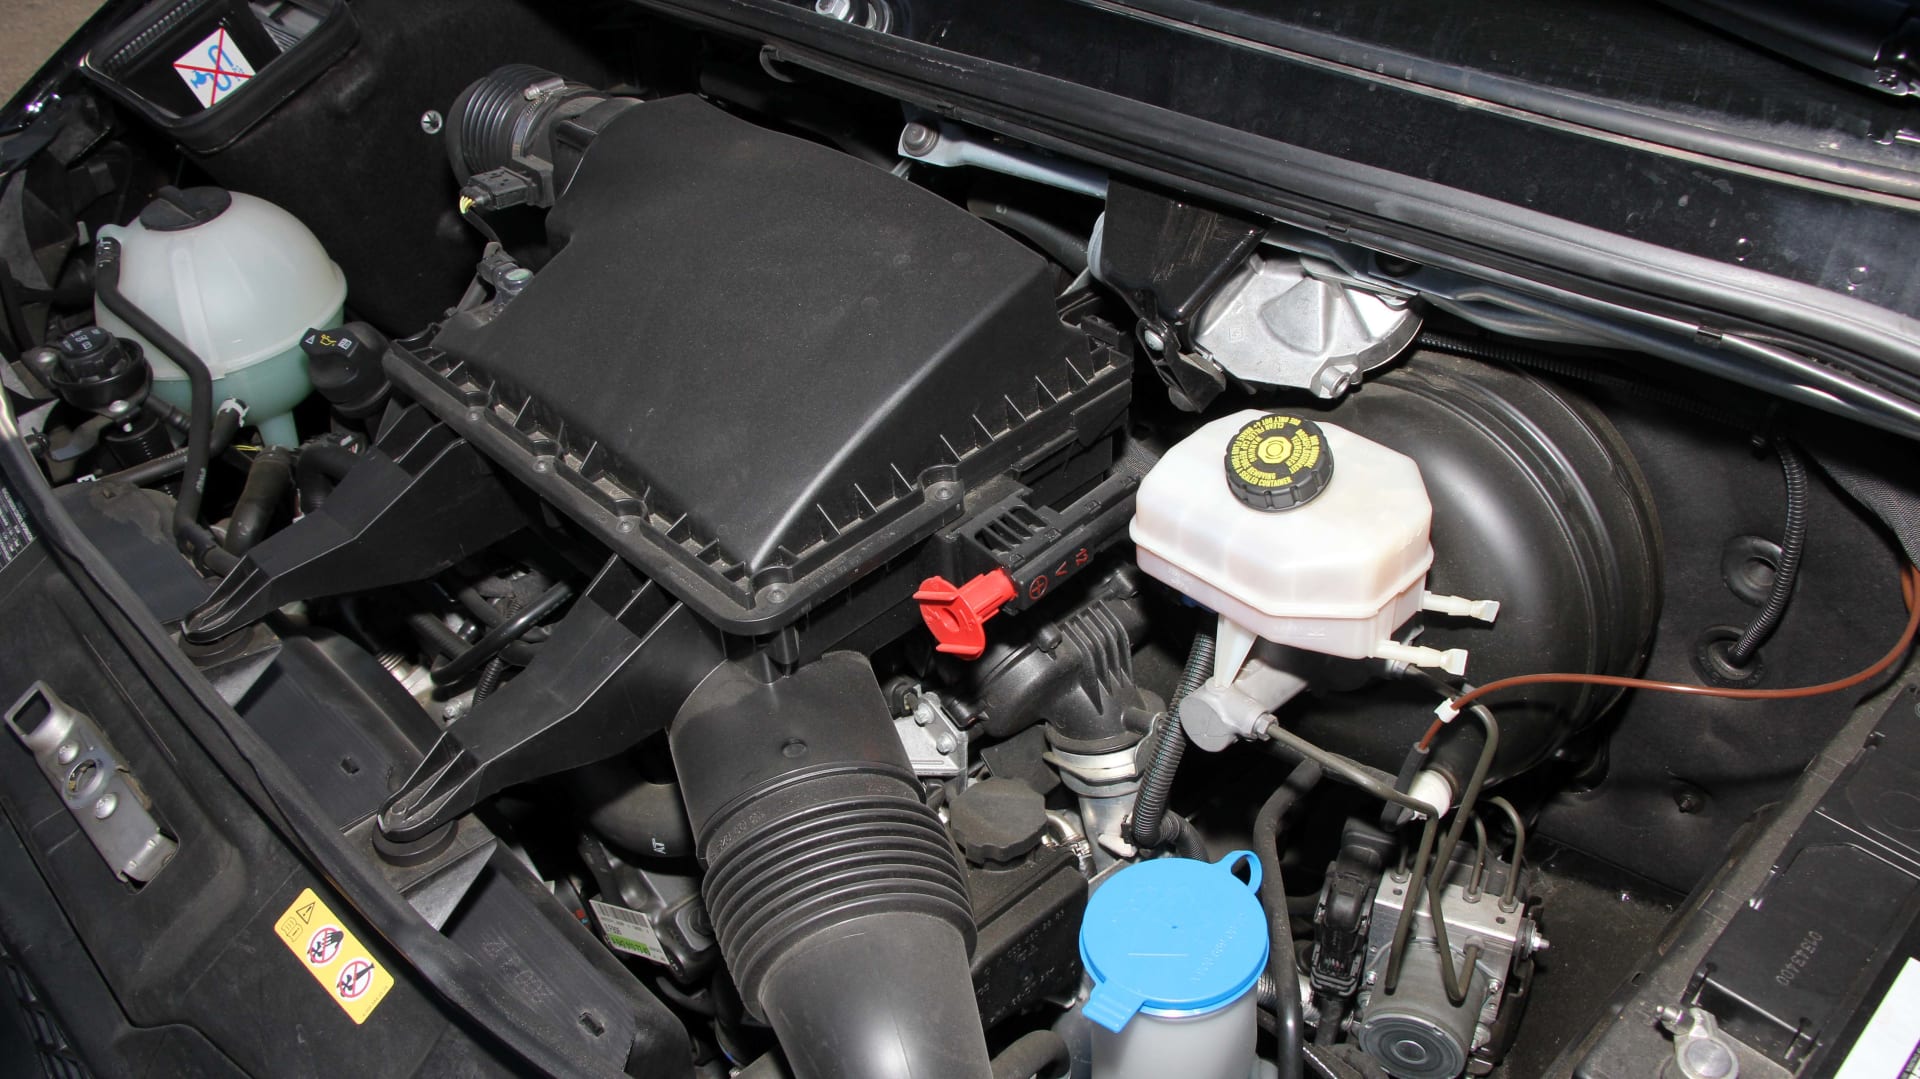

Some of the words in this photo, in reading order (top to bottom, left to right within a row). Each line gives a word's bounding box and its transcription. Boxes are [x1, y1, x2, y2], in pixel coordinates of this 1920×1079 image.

[1263, 417, 1274, 425] DOT
[1266, 423, 1285, 431] CLEAN
[1237, 426, 1255, 441] BRAKE
[1232, 441, 1243, 455] FLUID
[1247, 437, 1263, 463] WARNING
[1232, 454, 1242, 469] FROM
[1239, 450, 1252, 469] BEFORE
[1239, 471, 1259, 485] SEALED
[1247, 467, 1276, 480] REMOVING
